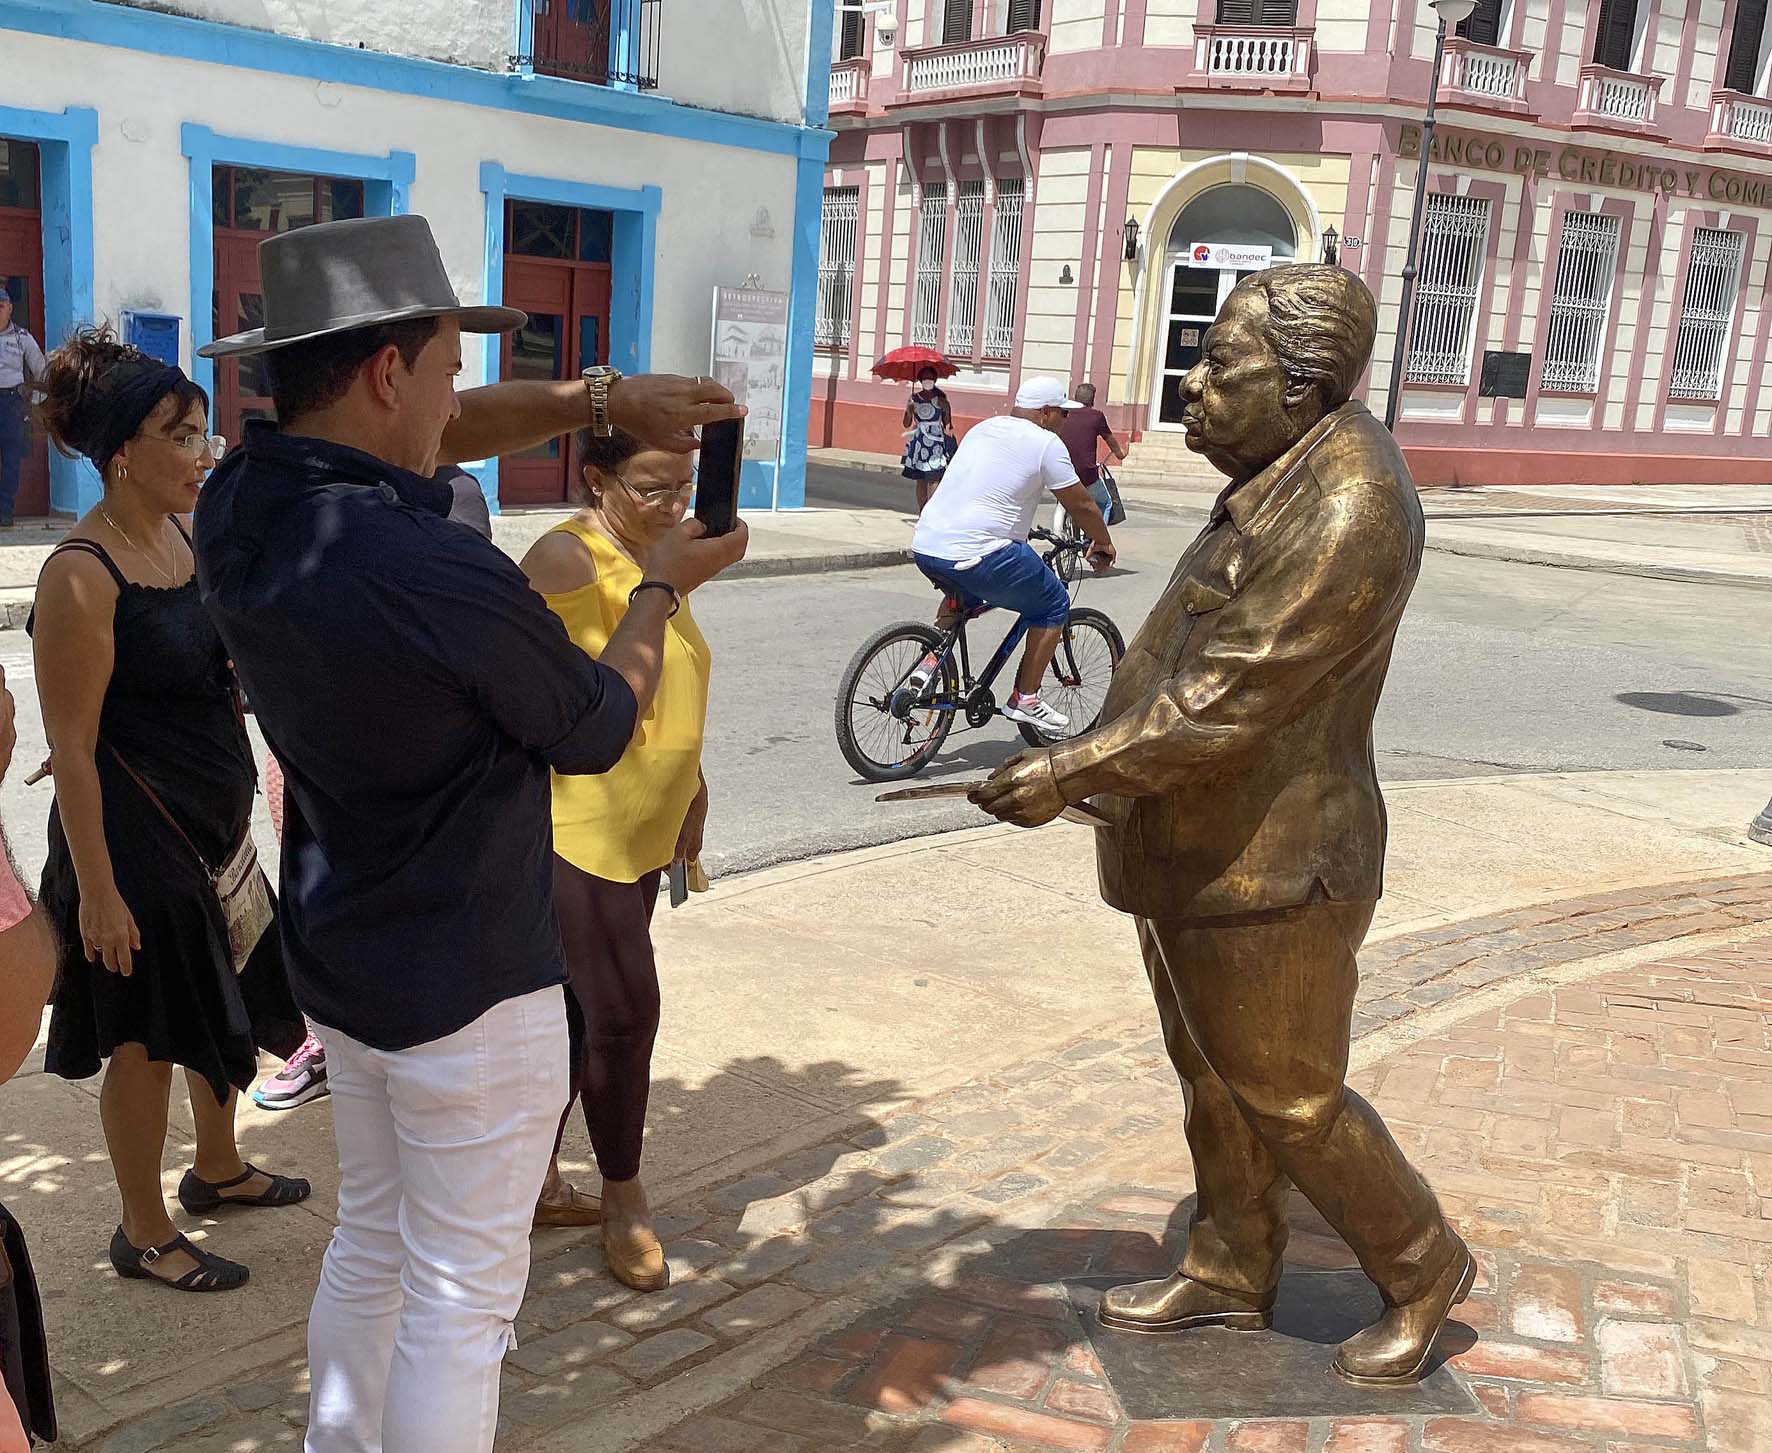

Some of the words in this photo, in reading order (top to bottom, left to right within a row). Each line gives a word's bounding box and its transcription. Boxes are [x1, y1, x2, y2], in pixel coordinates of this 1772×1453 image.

[1399, 124, 1505, 168] BANCO
[1514, 146, 1551, 174] DE
[1559, 147, 1678, 192] CRÉDITO
[1685, 171, 1700, 196] Y
[1229, 253, 1267, 261] bandec
